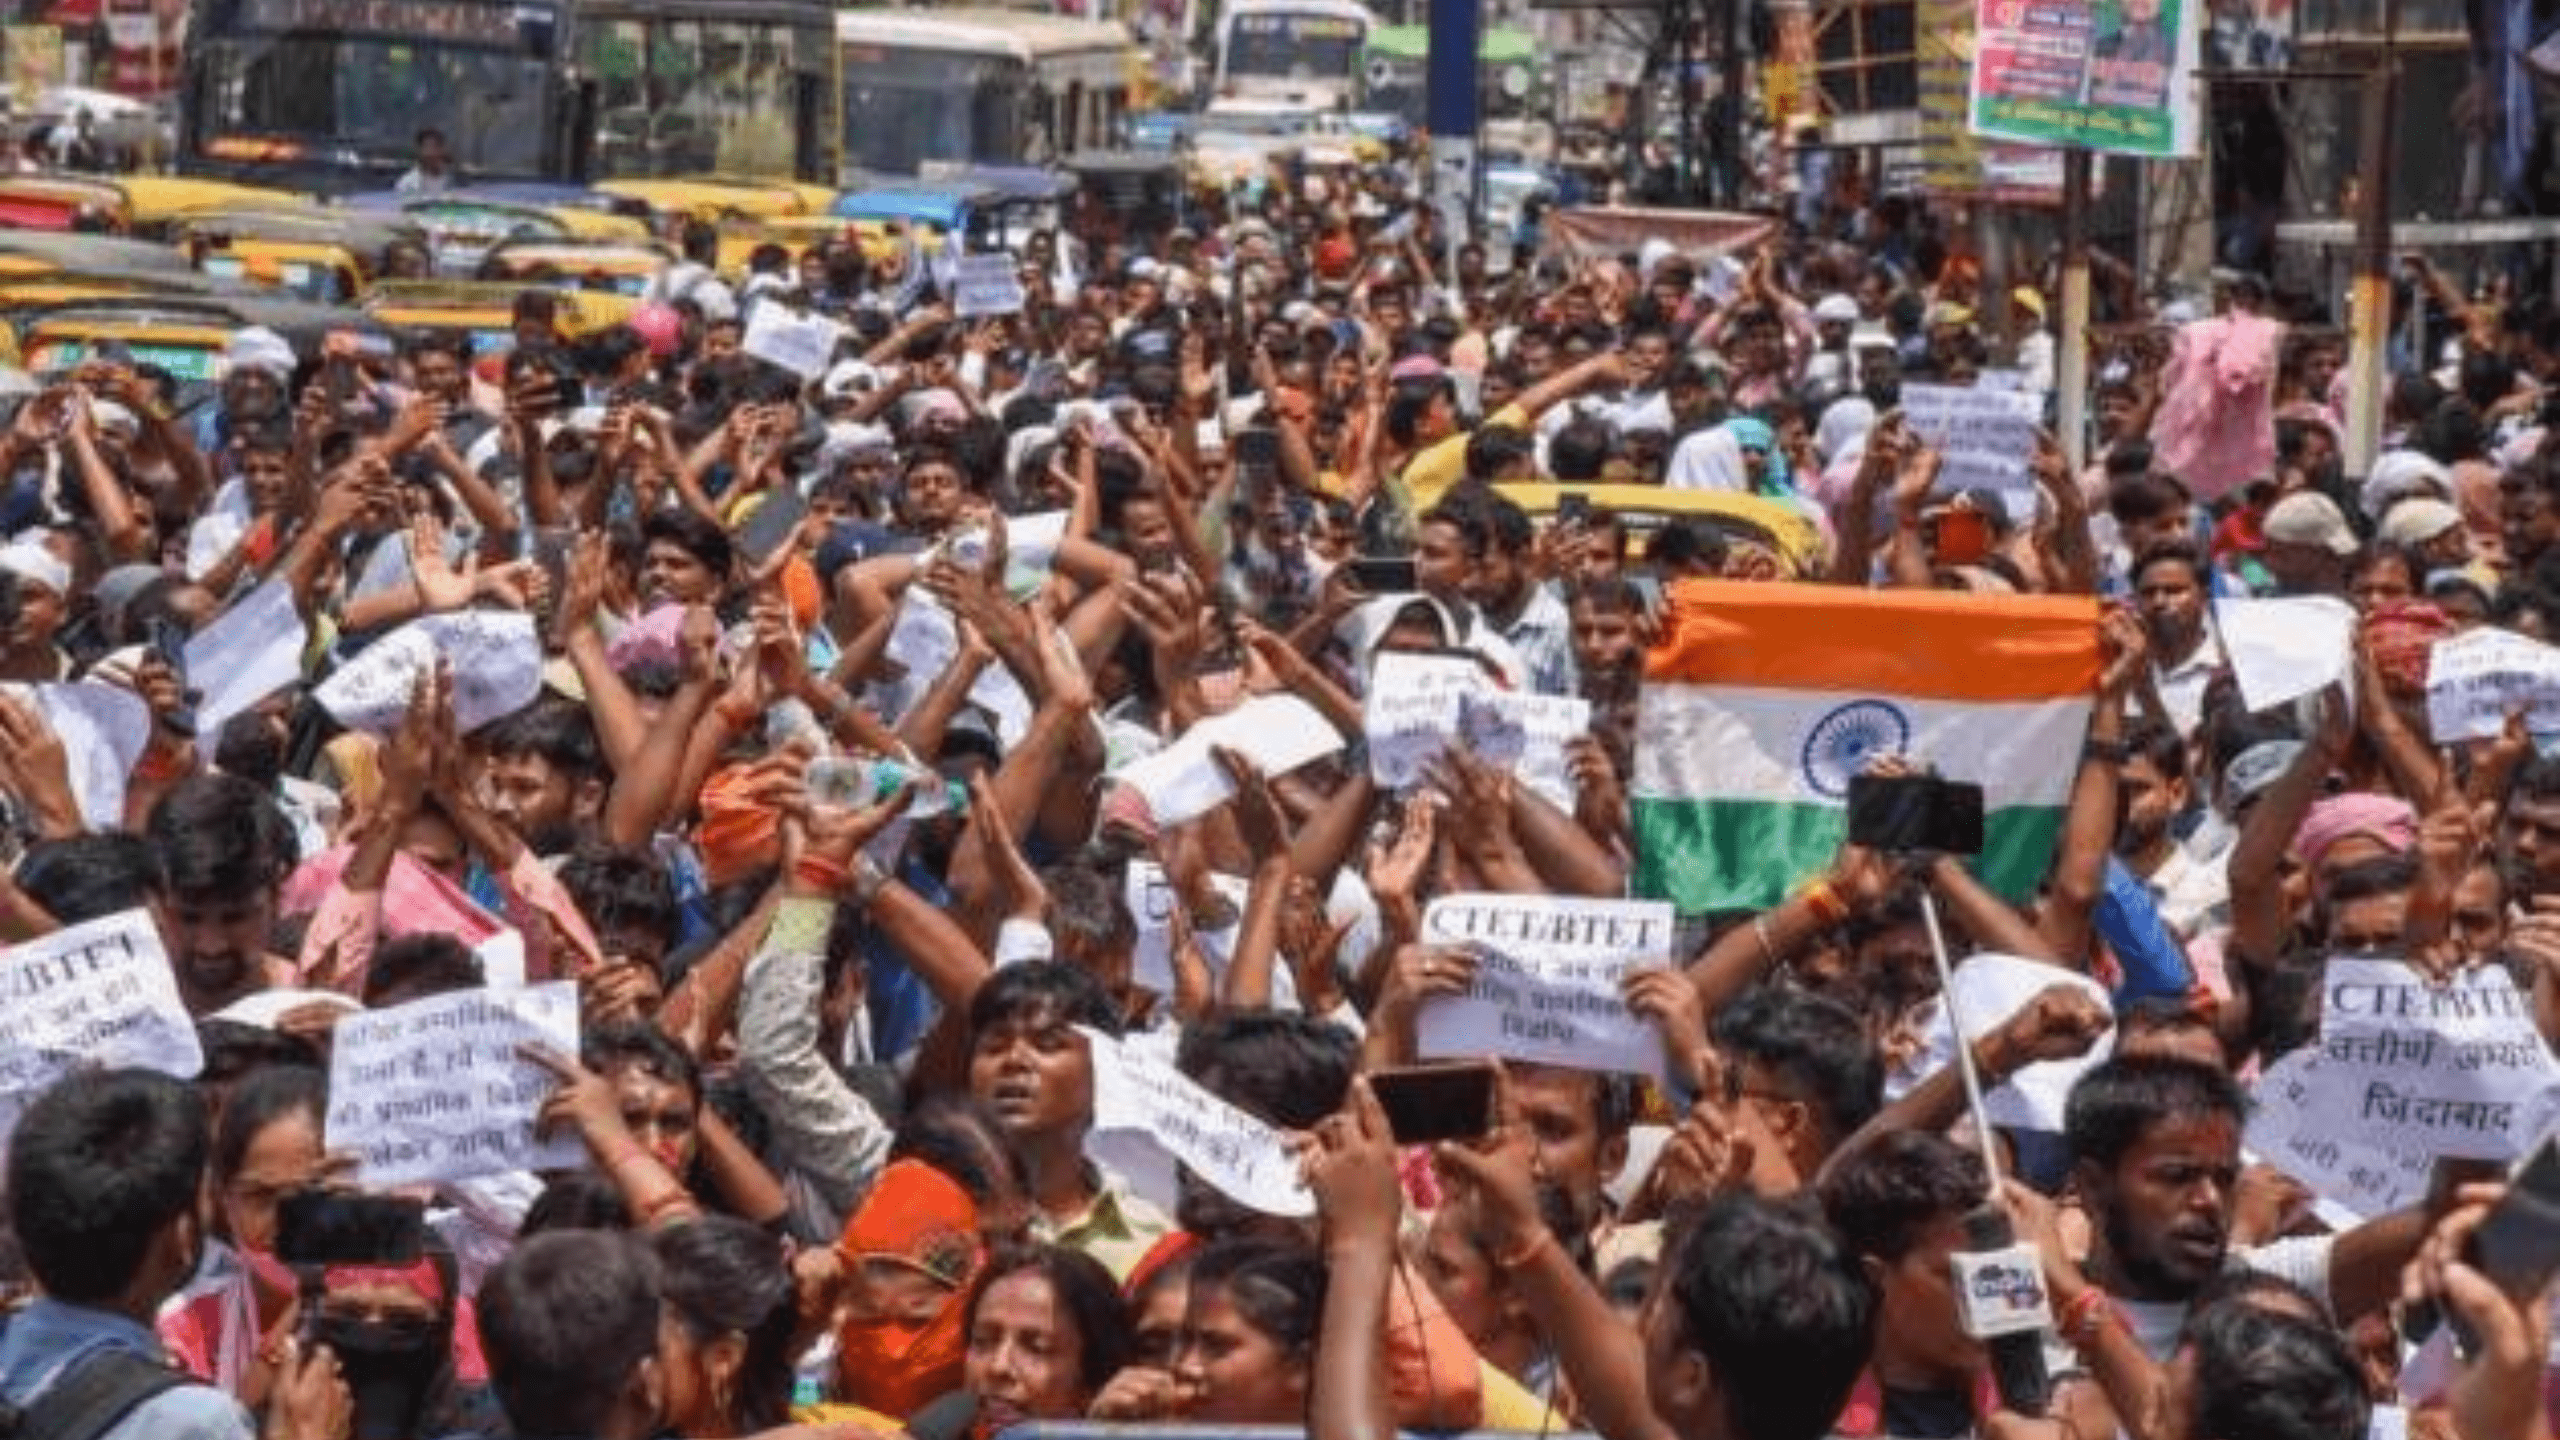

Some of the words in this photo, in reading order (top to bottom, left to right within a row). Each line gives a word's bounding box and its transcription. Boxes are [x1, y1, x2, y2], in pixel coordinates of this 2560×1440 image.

[1431, 906, 1659, 949] CTET/BTET
[0, 931, 136, 998] /BTET
[2362, 1080, 2513, 1133] जिंदाबाद
